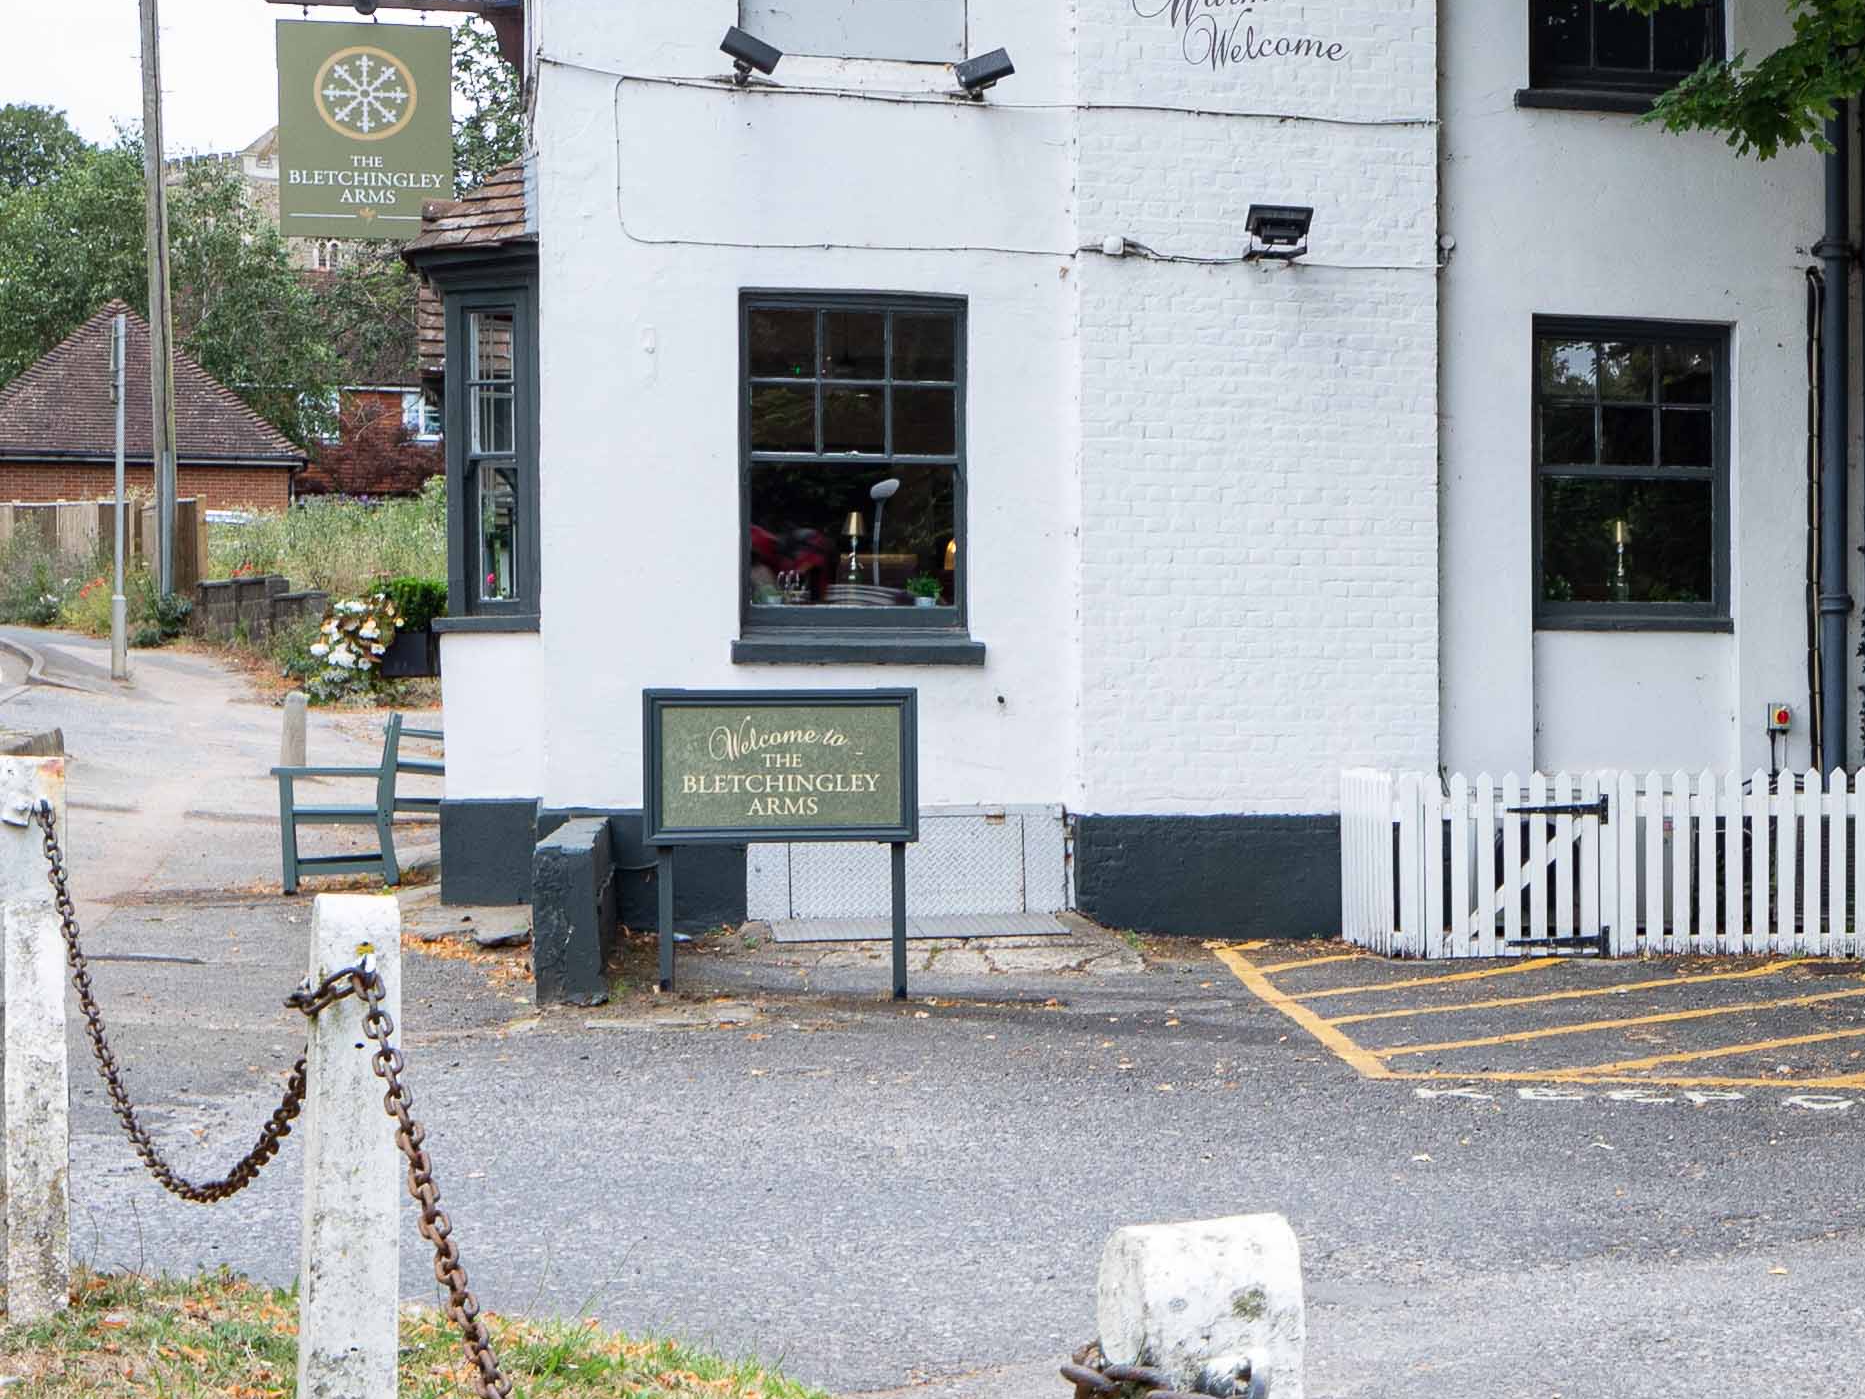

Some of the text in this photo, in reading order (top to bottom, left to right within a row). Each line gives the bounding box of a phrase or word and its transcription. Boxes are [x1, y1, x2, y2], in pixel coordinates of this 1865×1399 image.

[1183, 8, 1352, 71] Welcome
[350, 155, 383, 169] THE
[288, 169, 445, 189] BLETCHINGLEY
[340, 189, 397, 204] ARMS
[708, 716, 849, 762] Welcome to
[761, 753, 803, 768] THE
[682, 773, 880, 794] BLETCHINGLEY
[746, 796, 819, 816] ARMS
[1414, 1087, 1747, 1104] KEEP
